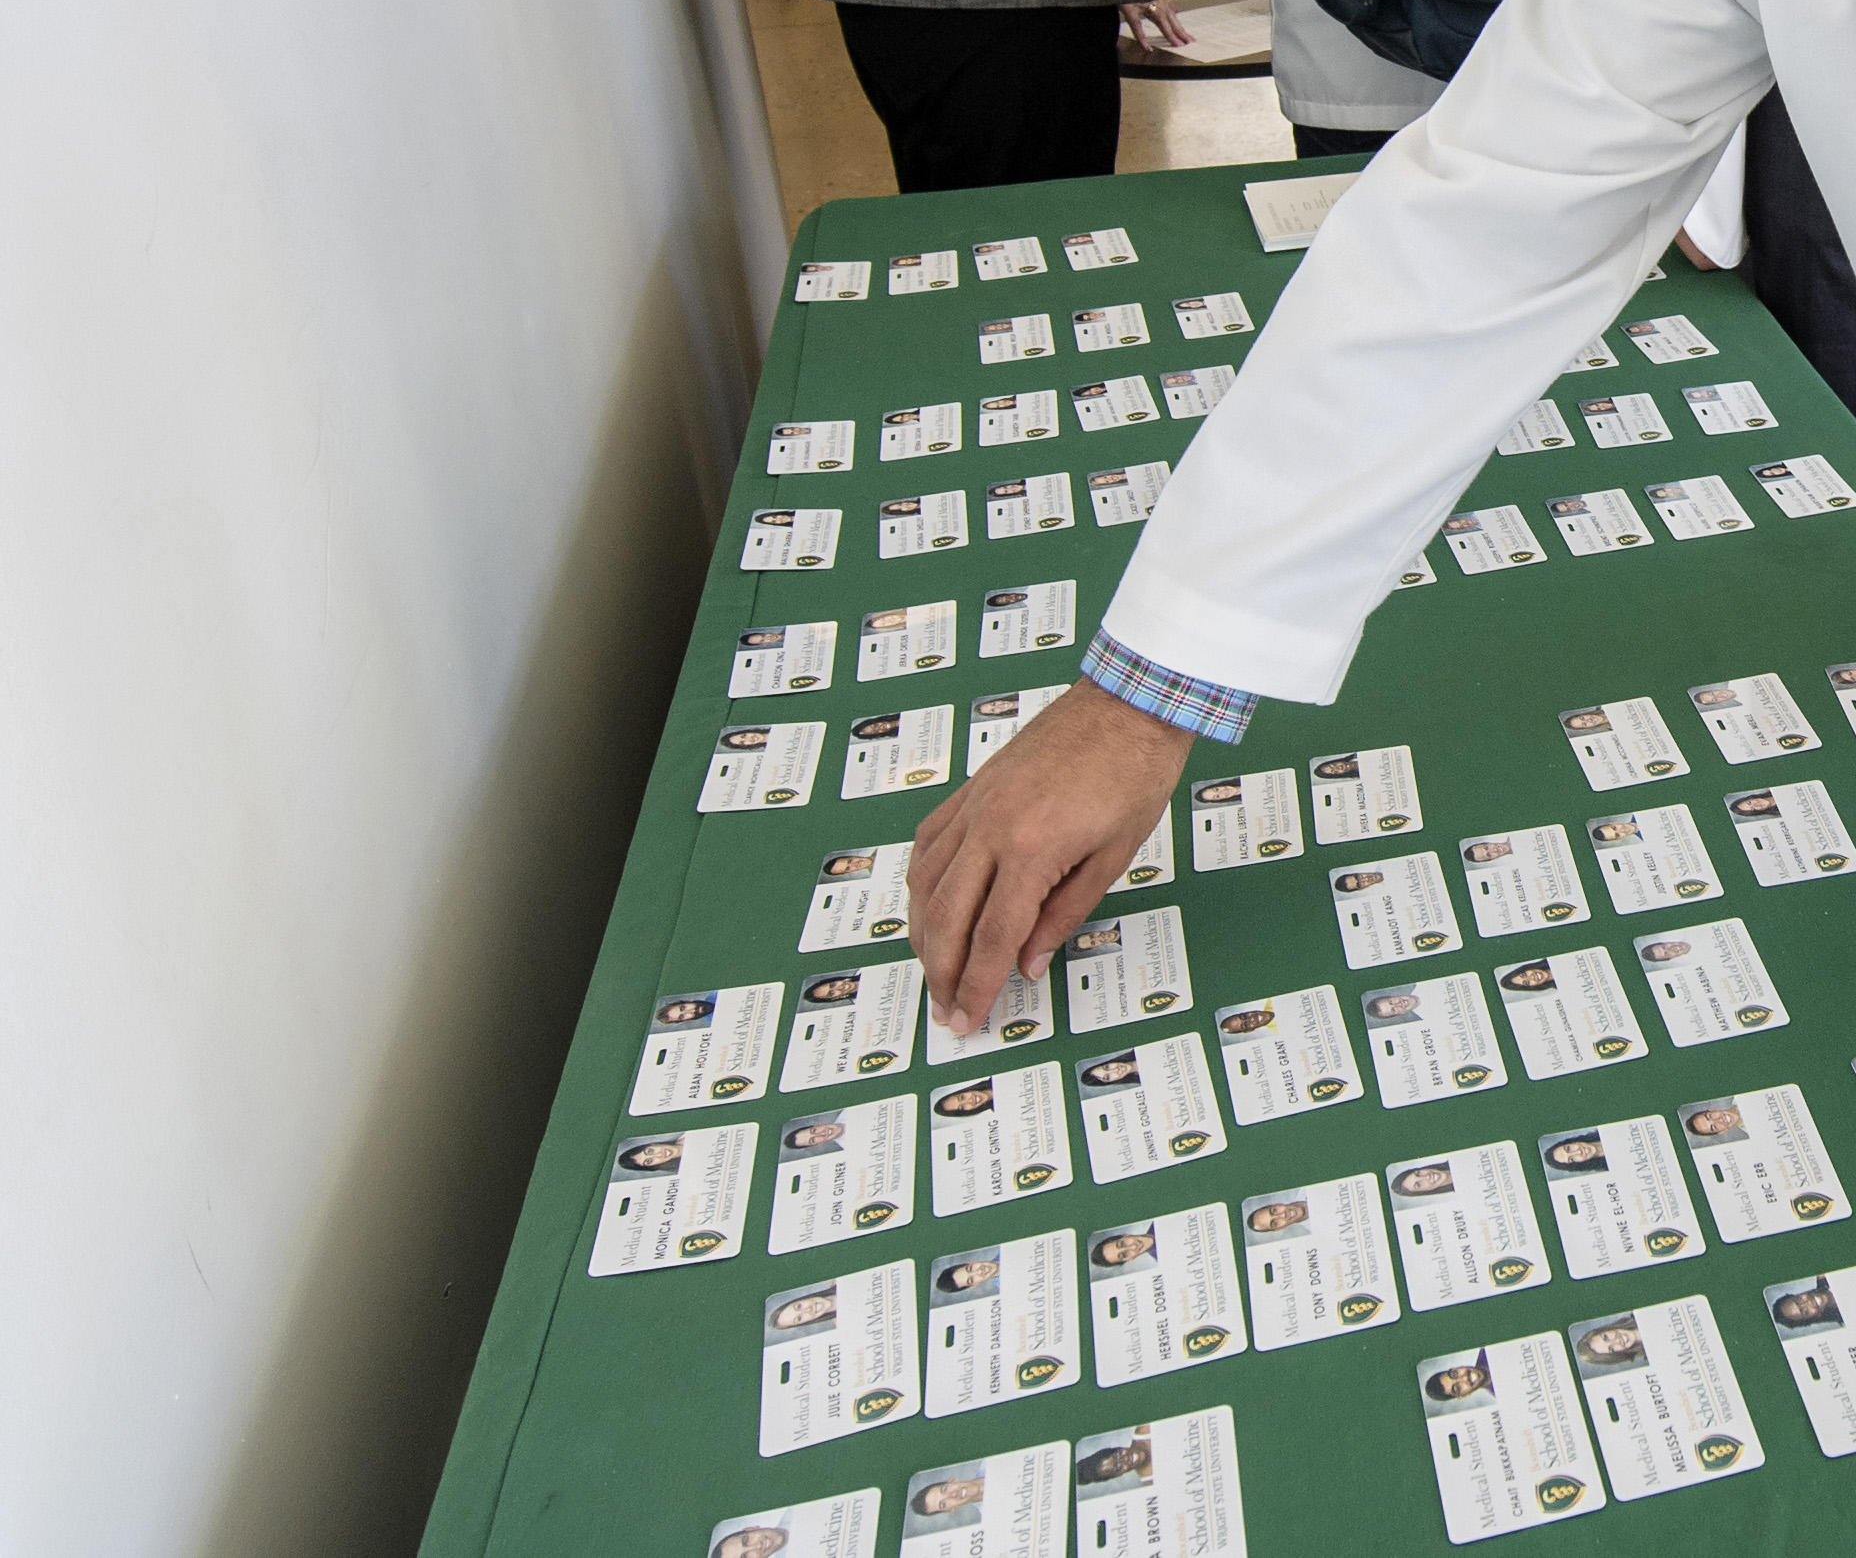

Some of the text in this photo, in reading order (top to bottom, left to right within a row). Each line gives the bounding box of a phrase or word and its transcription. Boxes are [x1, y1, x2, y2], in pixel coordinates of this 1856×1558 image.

[1237, 831, 1249, 860] RACHAEL
[1641, 850, 1667, 895] JUSTIN KELLEY
[850, 888, 871, 931] NEIL KNIGHT
[1380, 894, 1406, 956] RAMANJOT KANG
[839, 1010, 857, 1044] HUSSAIN
[1693, 965, 1731, 1032] MATTHEW HABINA
[686, 1031, 713, 1100] ALBAN HOLYOKE
[1273, 1039, 1300, 1105] CHARLES GRANT
[1419, 1027, 1444, 1086] BRYAN GROVE
[694, 1129, 728, 1225] School of Medicine
[719, 1128, 745, 1220] WRIGHT STATE UNIVERSITY
[986, 1118, 1004, 1197] KAROLIN GINTING
[1141, 1128, 1159, 1163] JENNIFER
[1751, 1161, 1779, 1204] ERIC ERB
[618, 1184, 652, 1266] Medical Student
[651, 1177, 682, 1260] MONICA GANDHI
[828, 1160, 847, 1227] JOHN GILTNER
[1604, 1181, 1636, 1253] NIVINE EL-HOR
[1304, 1246, 1327, 1320] TONY DOWNS
[1451, 1207, 1480, 1285] ALLISON DRURY
[865, 1270, 885, 1385] School of Medicine
[889, 1266, 903, 1377] WRIGHT STATE UNIVERSITY
[988, 1297, 1002, 1395] KENNETH DANIELSON
[1150, 1273, 1173, 1361] HERSHEL DOBKIN
[792, 1343, 812, 1442] Medical Student
[826, 1341, 841, 1420] JULIE CORBETT
[1517, 1342, 1545, 1405] Medicine
[1537, 1338, 1579, 1462] WRIGHT STATE UNIVERSITY
[1528, 1407, 1549, 1421] of
[1532, 1421, 1561, 1470] School
[1643, 1371, 1689, 1474] MELISSA BURTOFT
[1011, 1454, 1036, 1543] of Medicine
[1038, 1451, 1054, 1548] STATE UNIVERSITY
[1183, 1419, 1209, 1557] School of Medicine
[1207, 1415, 1228, 1550] WRIGHT STATE UNIVERSITY
[1462, 1418, 1498, 1530] Medical Student
[1506, 1485, 1525, 1518] CHAIT
[1111, 1502, 1128, 1558] Student
[1146, 1495, 1161, 1544] BROWN
